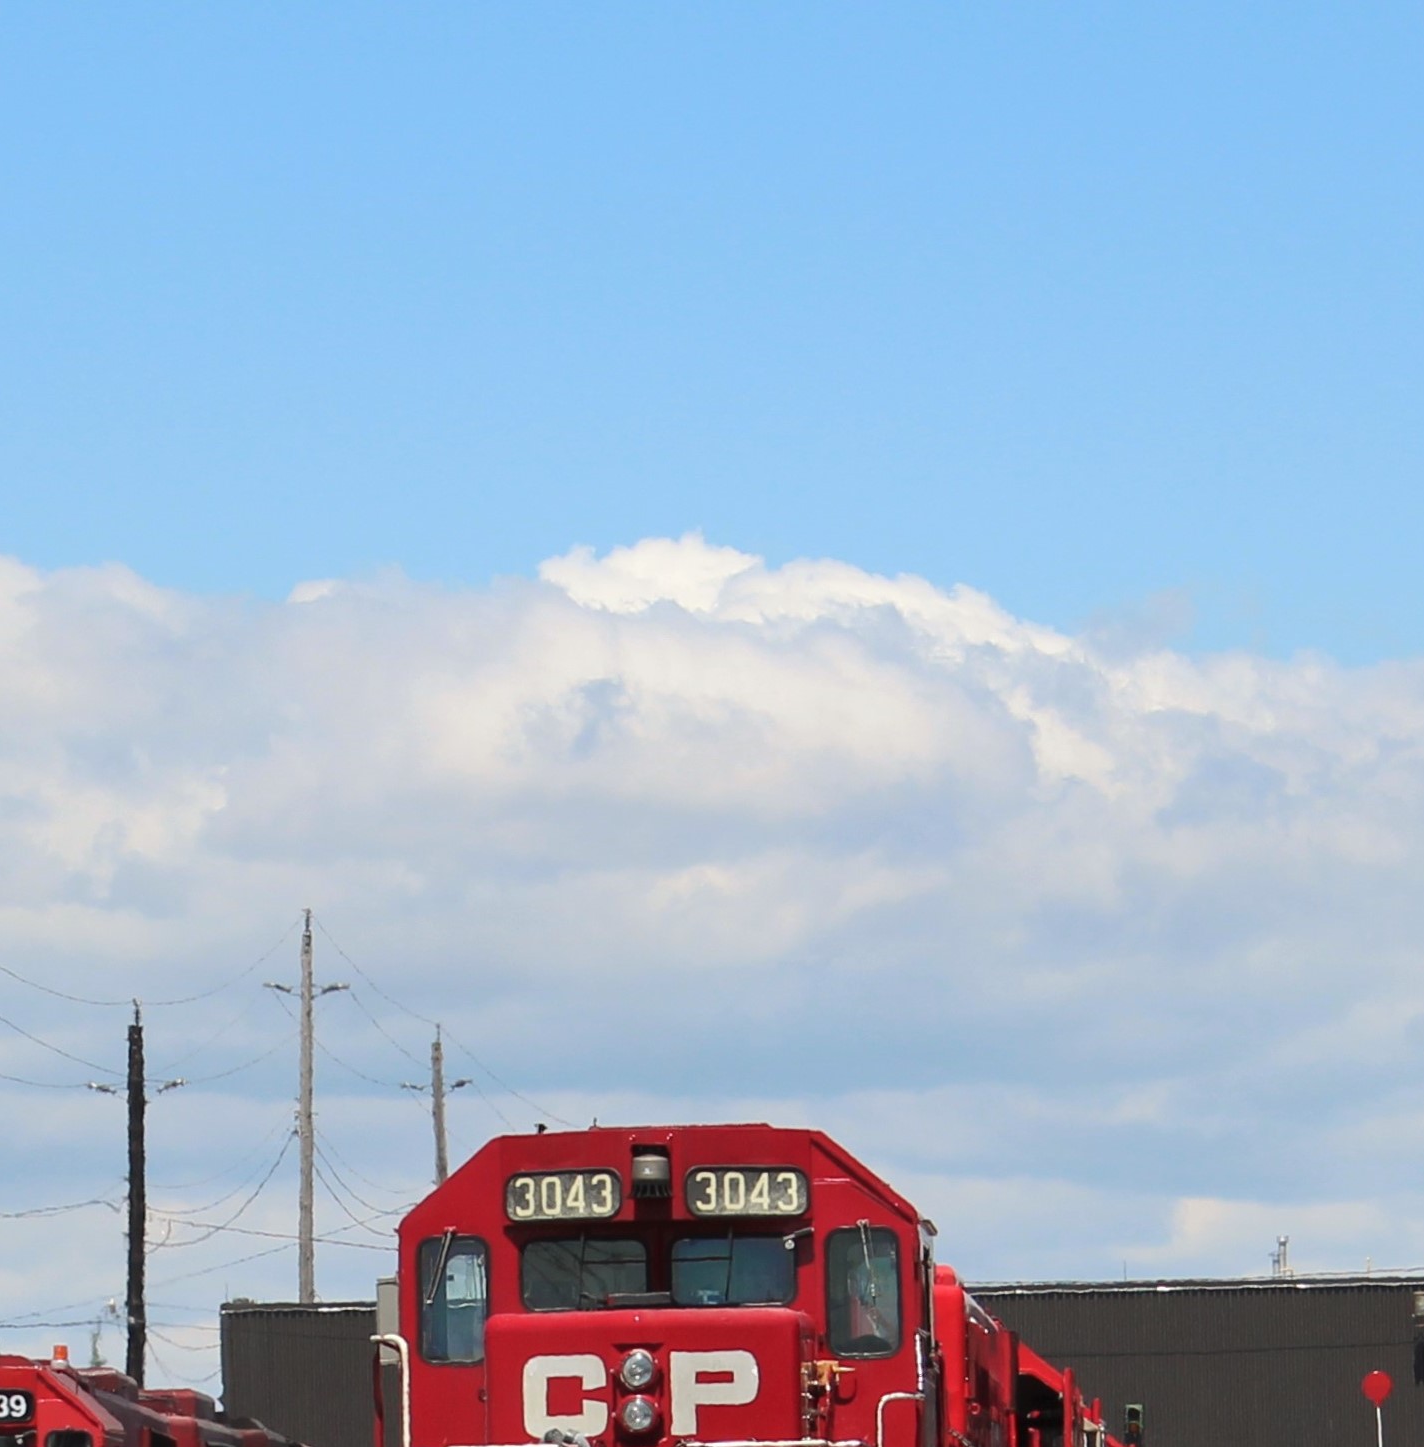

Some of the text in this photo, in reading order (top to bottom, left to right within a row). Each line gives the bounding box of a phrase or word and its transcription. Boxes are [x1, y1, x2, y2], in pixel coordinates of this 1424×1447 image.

[514, 1173, 613, 1216] 3043
[695, 1171, 798, 1212] 3043
[523, 1350, 760, 1440] CP
